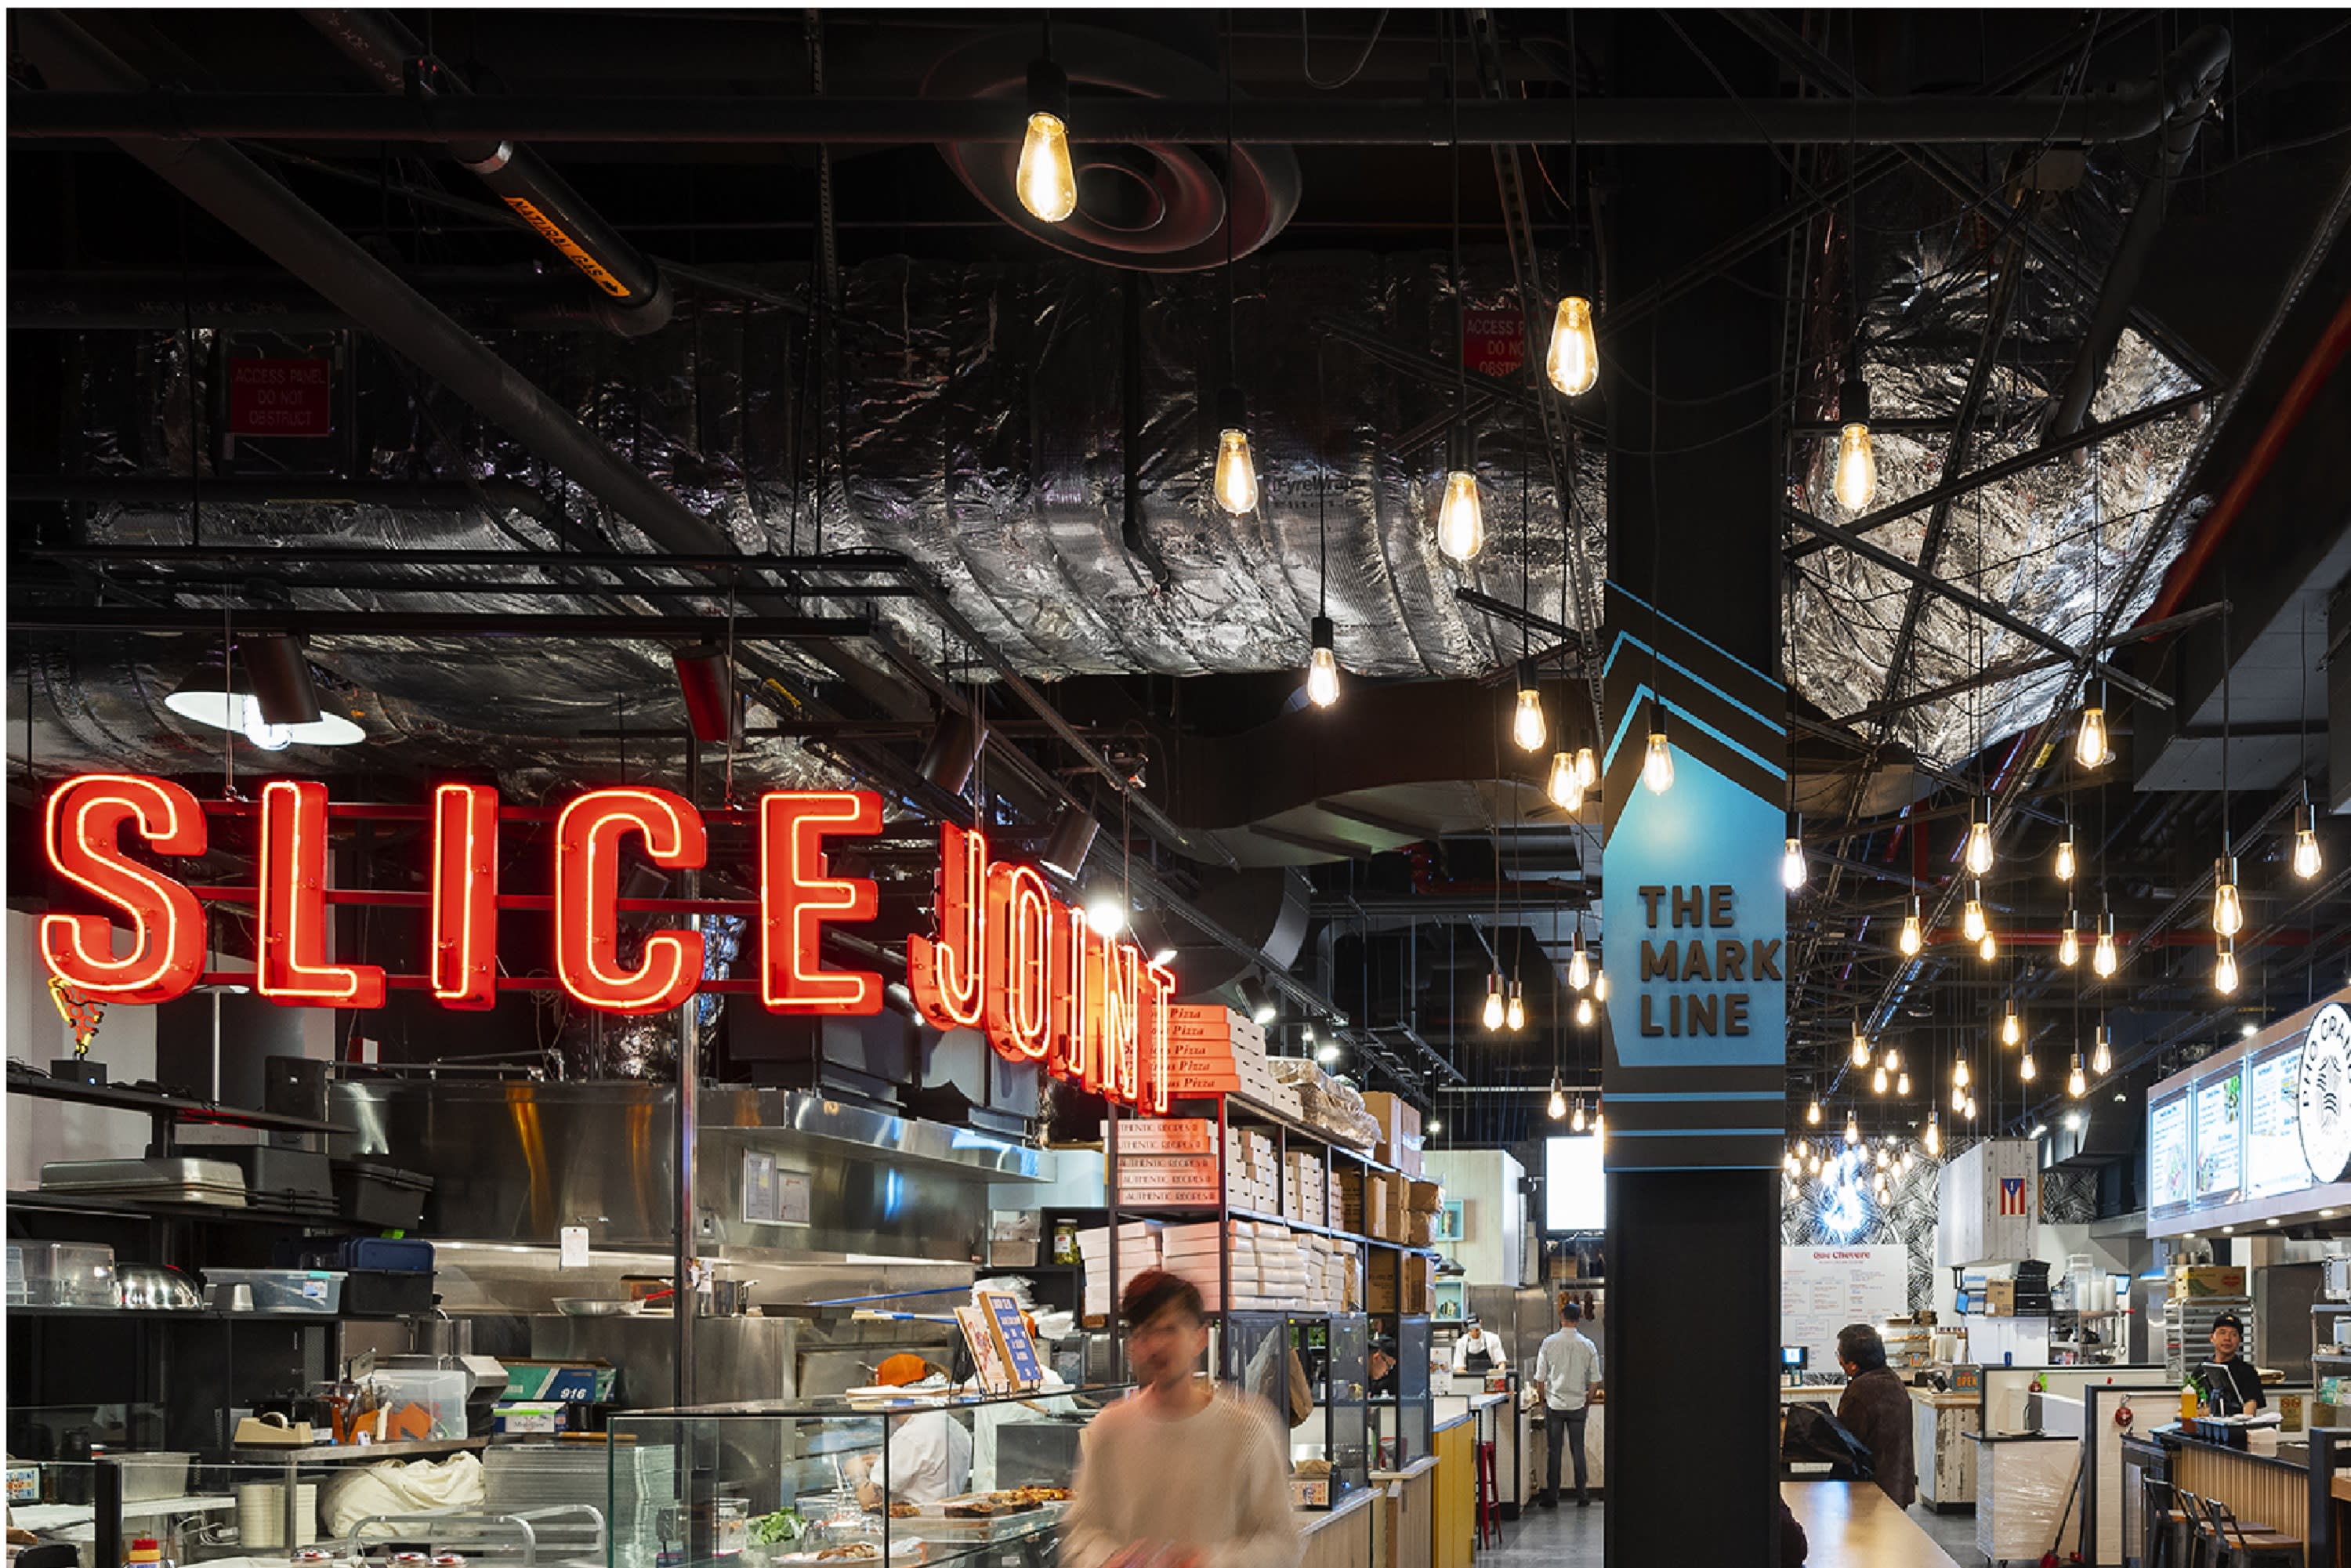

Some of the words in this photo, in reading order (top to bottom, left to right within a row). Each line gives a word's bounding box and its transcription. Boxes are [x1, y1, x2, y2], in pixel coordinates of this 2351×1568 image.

[1466, 320, 1514, 335] ACCESS
[1488, 341, 1505, 356] DO
[1509, 341, 1524, 356] NO
[236, 368, 286, 385] ACCESS
[290, 368, 326, 384] PANEL
[1479, 361, 1523, 378] OBSTR
[257, 389, 274, 405] DO
[281, 389, 304, 405] NOT
[248, 410, 313, 426] OBSTRUCT
[39, 773, 883, 1016] SLICE
[1639, 885, 1734, 928] THE
[906, 820, 1176, 1114] JOINT
[1170, 1008, 1201, 1019] Pizza
[1640, 994, 1750, 1037] LINE
[1172, 1025, 1204, 1035] Pizza
[1176, 1045, 1206, 1055] Pizza
[1179, 1060, 1210, 1070] Pizza
[1184, 1077, 1215, 1088] Pizza
